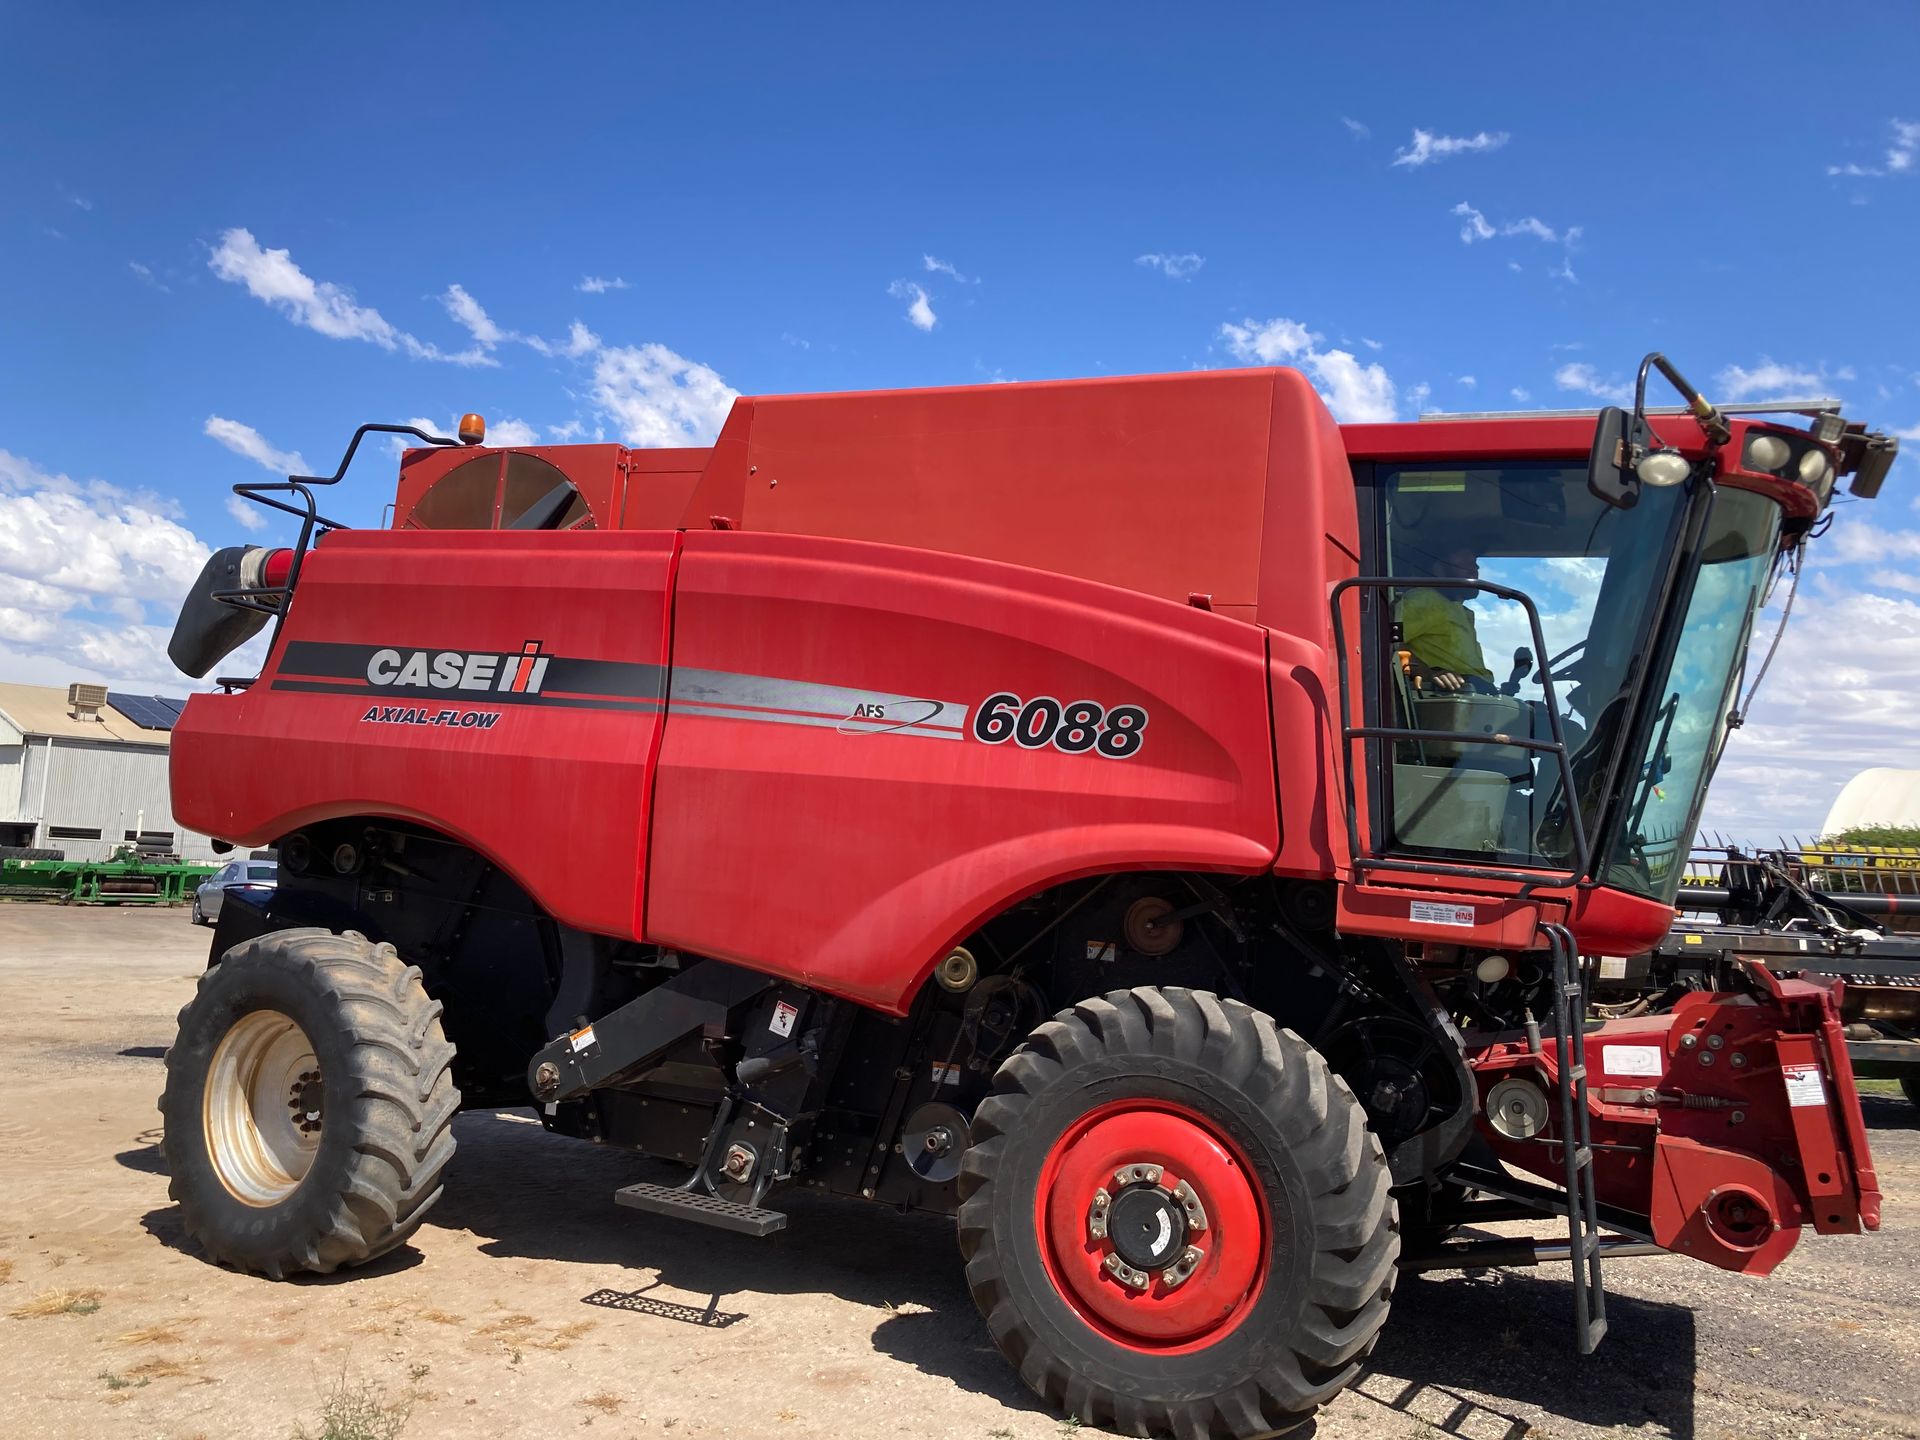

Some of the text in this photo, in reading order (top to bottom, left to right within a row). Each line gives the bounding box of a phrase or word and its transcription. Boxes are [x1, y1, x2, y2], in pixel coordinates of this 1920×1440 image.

[366, 648, 499, 692] CASE
[360, 705, 500, 730] AXIAL-FLOW
[854, 702, 886, 719] AFS
[973, 691, 1149, 760] 6088
[1455, 911, 1473, 921] HNS
